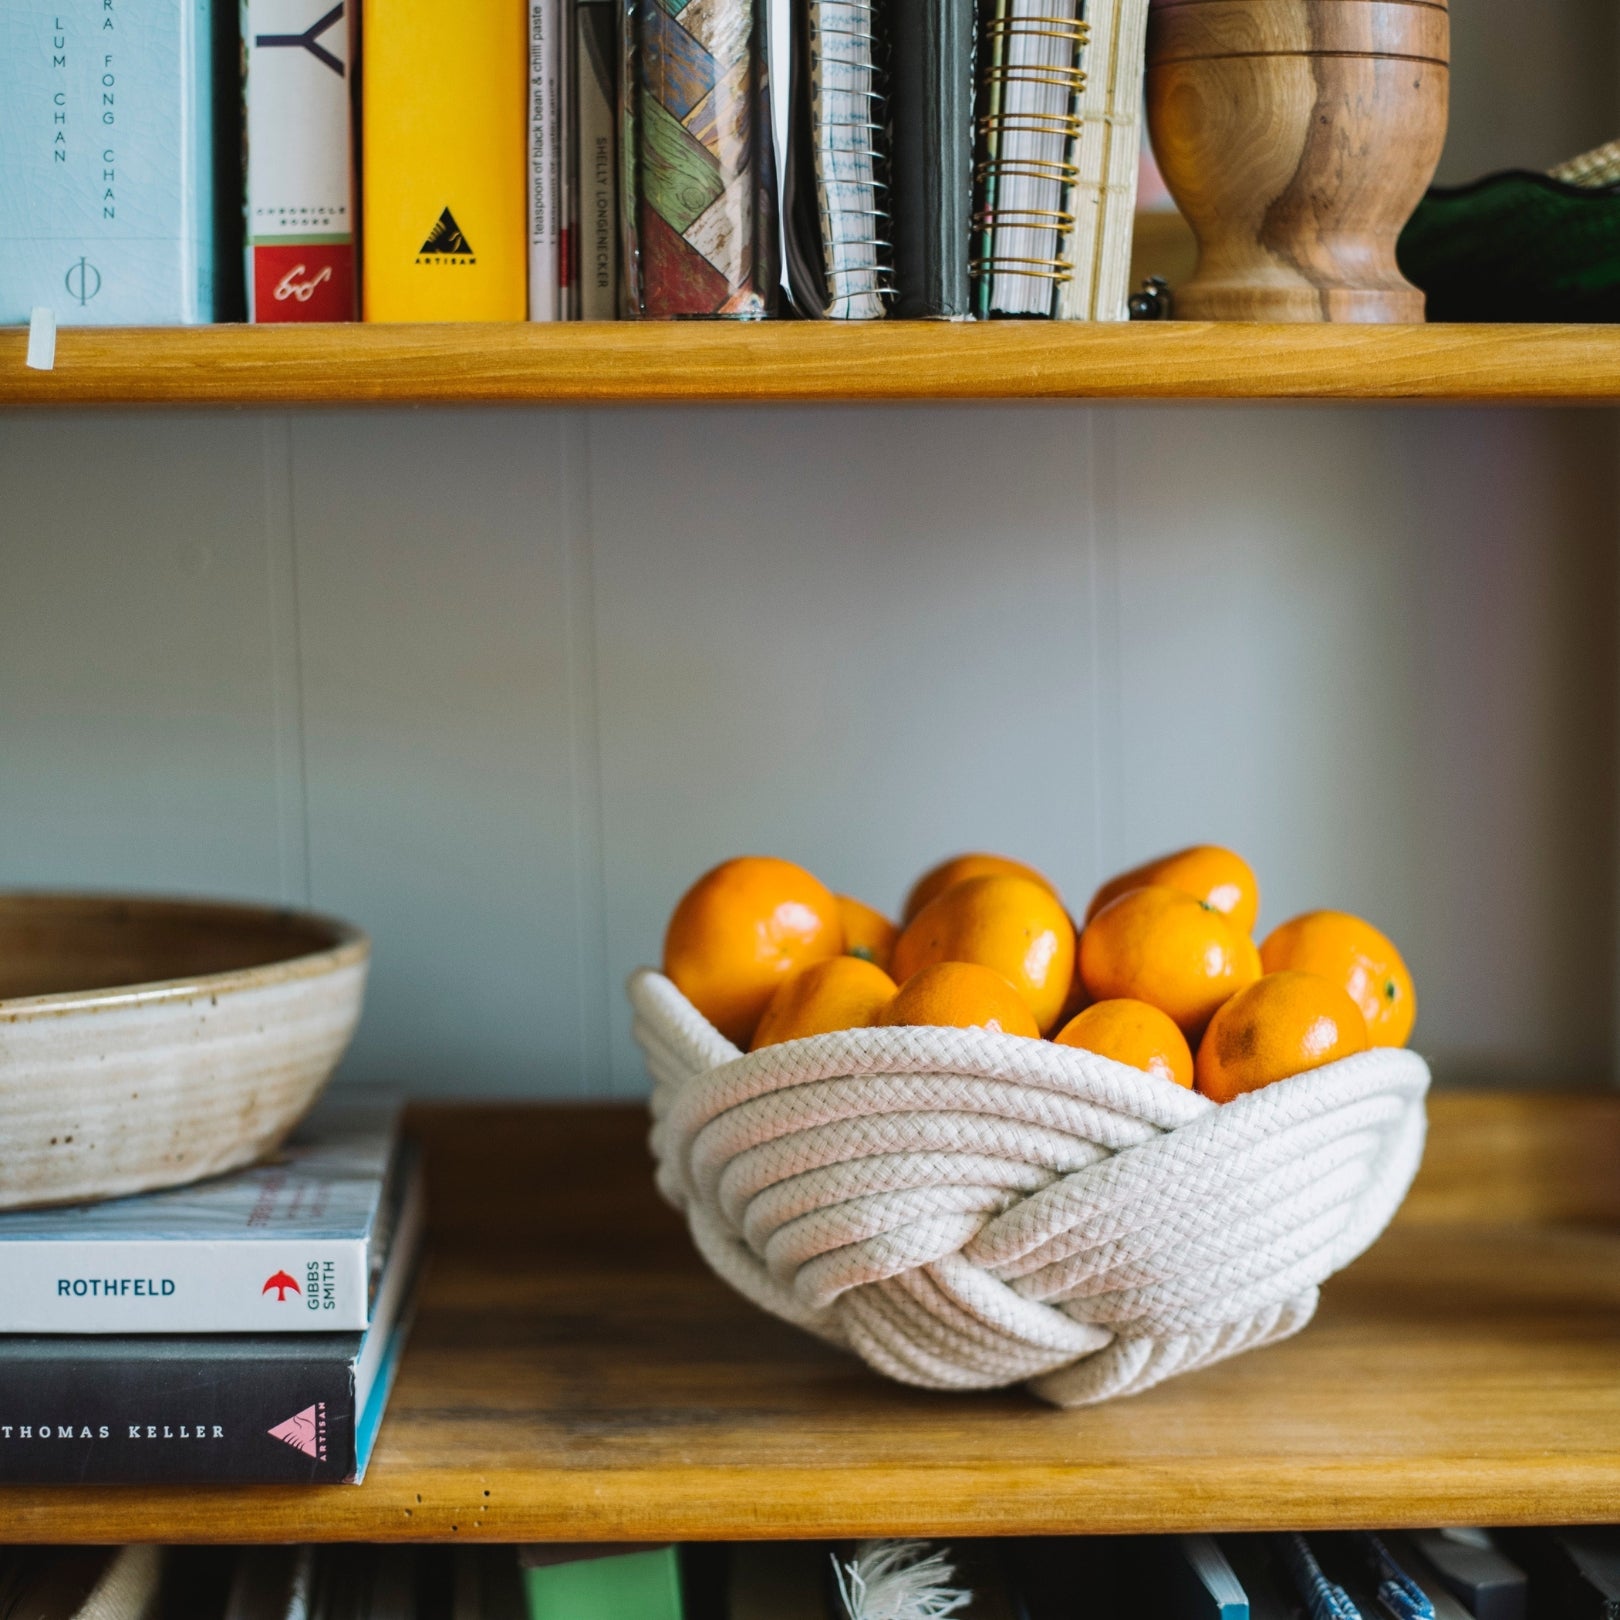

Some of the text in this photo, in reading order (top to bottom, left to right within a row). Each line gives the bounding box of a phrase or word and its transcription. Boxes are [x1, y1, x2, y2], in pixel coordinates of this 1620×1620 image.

[531, 5, 544, 41] paste
[531, 45, 543, 73] chilli
[53, 17, 66, 162] LUM CHAN
[102, 55, 115, 125] FONG
[531, 76, 543, 86] &
[532, 90, 543, 121] bean
[532, 125, 543, 158] black
[102, 149, 115, 219] CHAN
[532, 162, 543, 174] of
[533, 177, 545, 235] teaspoon
[596, 137, 608, 288] SHELLY LONGENECKER
[415, 257, 477, 265] ARTISAN
[57, 1279, 175, 1297] ROTHFELD
[307, 1261, 319, 1310] GIBBS
[323, 1261, 335, 1310] SMITH
[1, 1426, 224, 1438] THOMAS KELLER
[318, 1402, 327, 1462] ARTISAN
